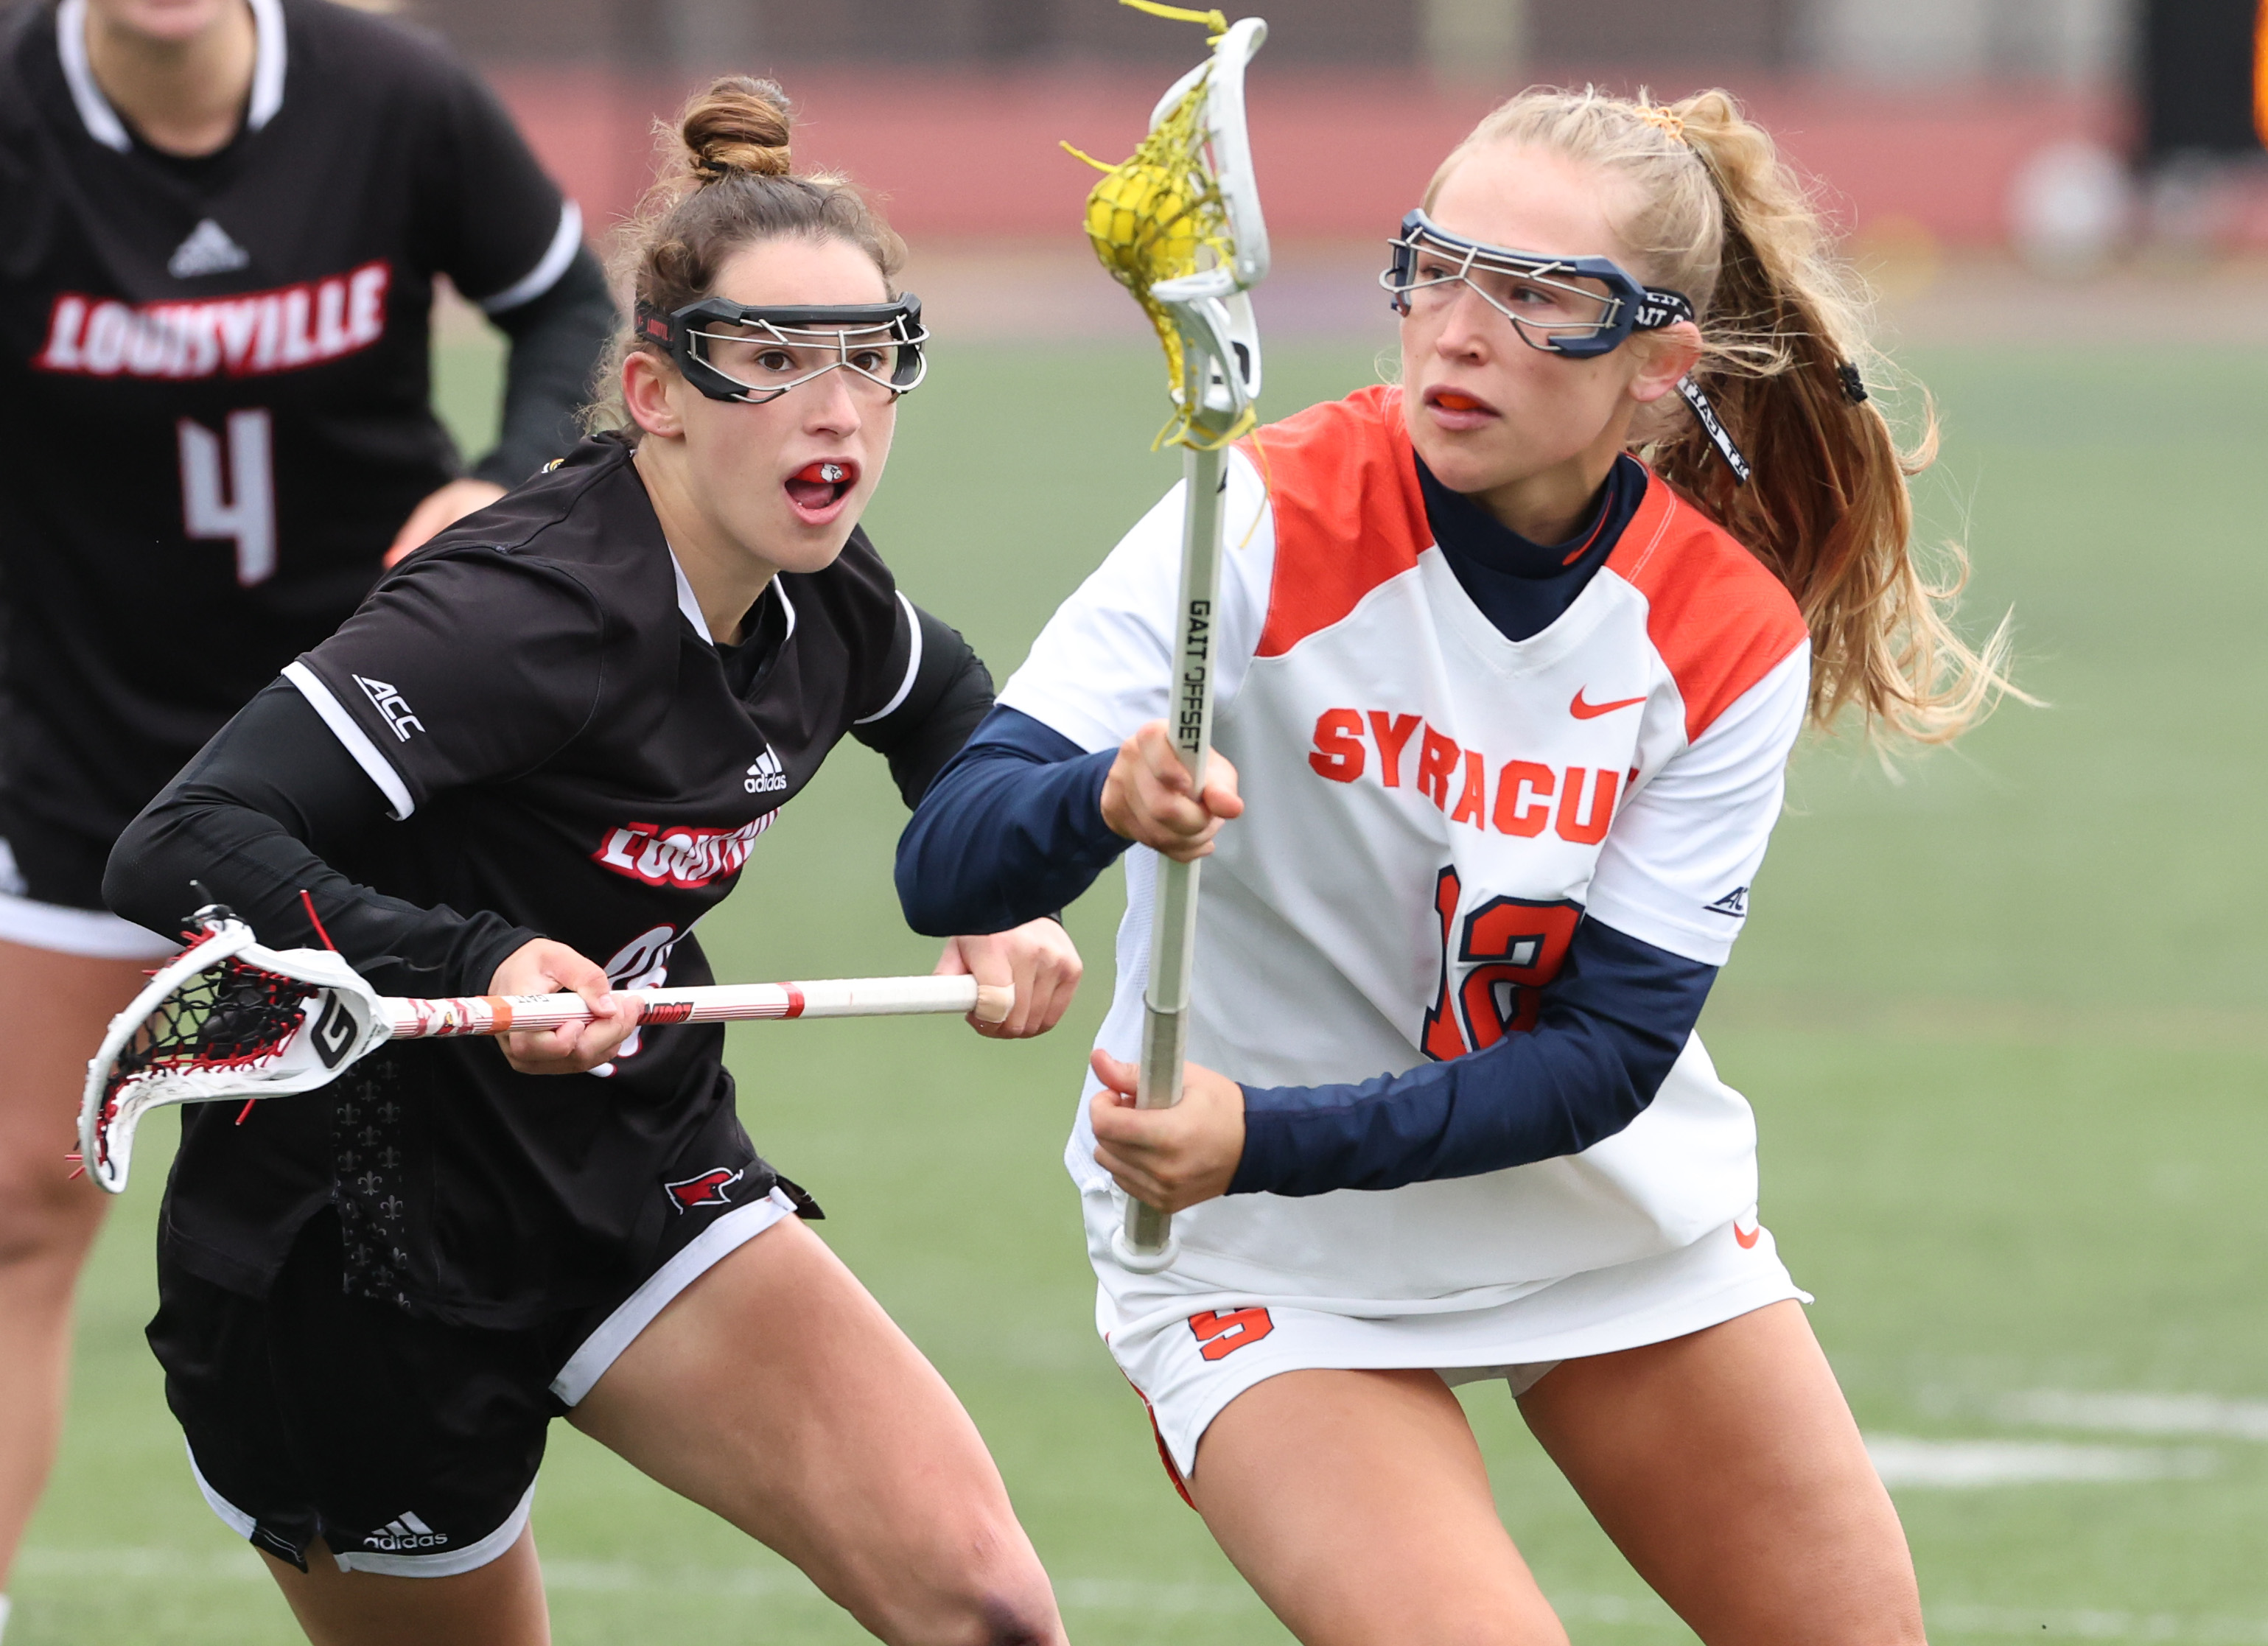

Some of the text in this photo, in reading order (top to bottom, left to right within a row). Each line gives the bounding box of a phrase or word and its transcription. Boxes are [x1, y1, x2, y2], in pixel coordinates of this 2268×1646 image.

[32, 258, 391, 379] LOUISVILLE
[176, 408, 279, 588] 4
[357, 675, 426, 740] ACC
[1179, 600, 1211, 754] GAIT OFFSET
[744, 772, 787, 794] adidas
[1309, 708, 1639, 845] SYRACU
[1709, 886, 1749, 914] AC
[1421, 864, 1586, 1062] 12
[1188, 1306, 1274, 1362] S
[363, 1533, 448, 1550] adidas
